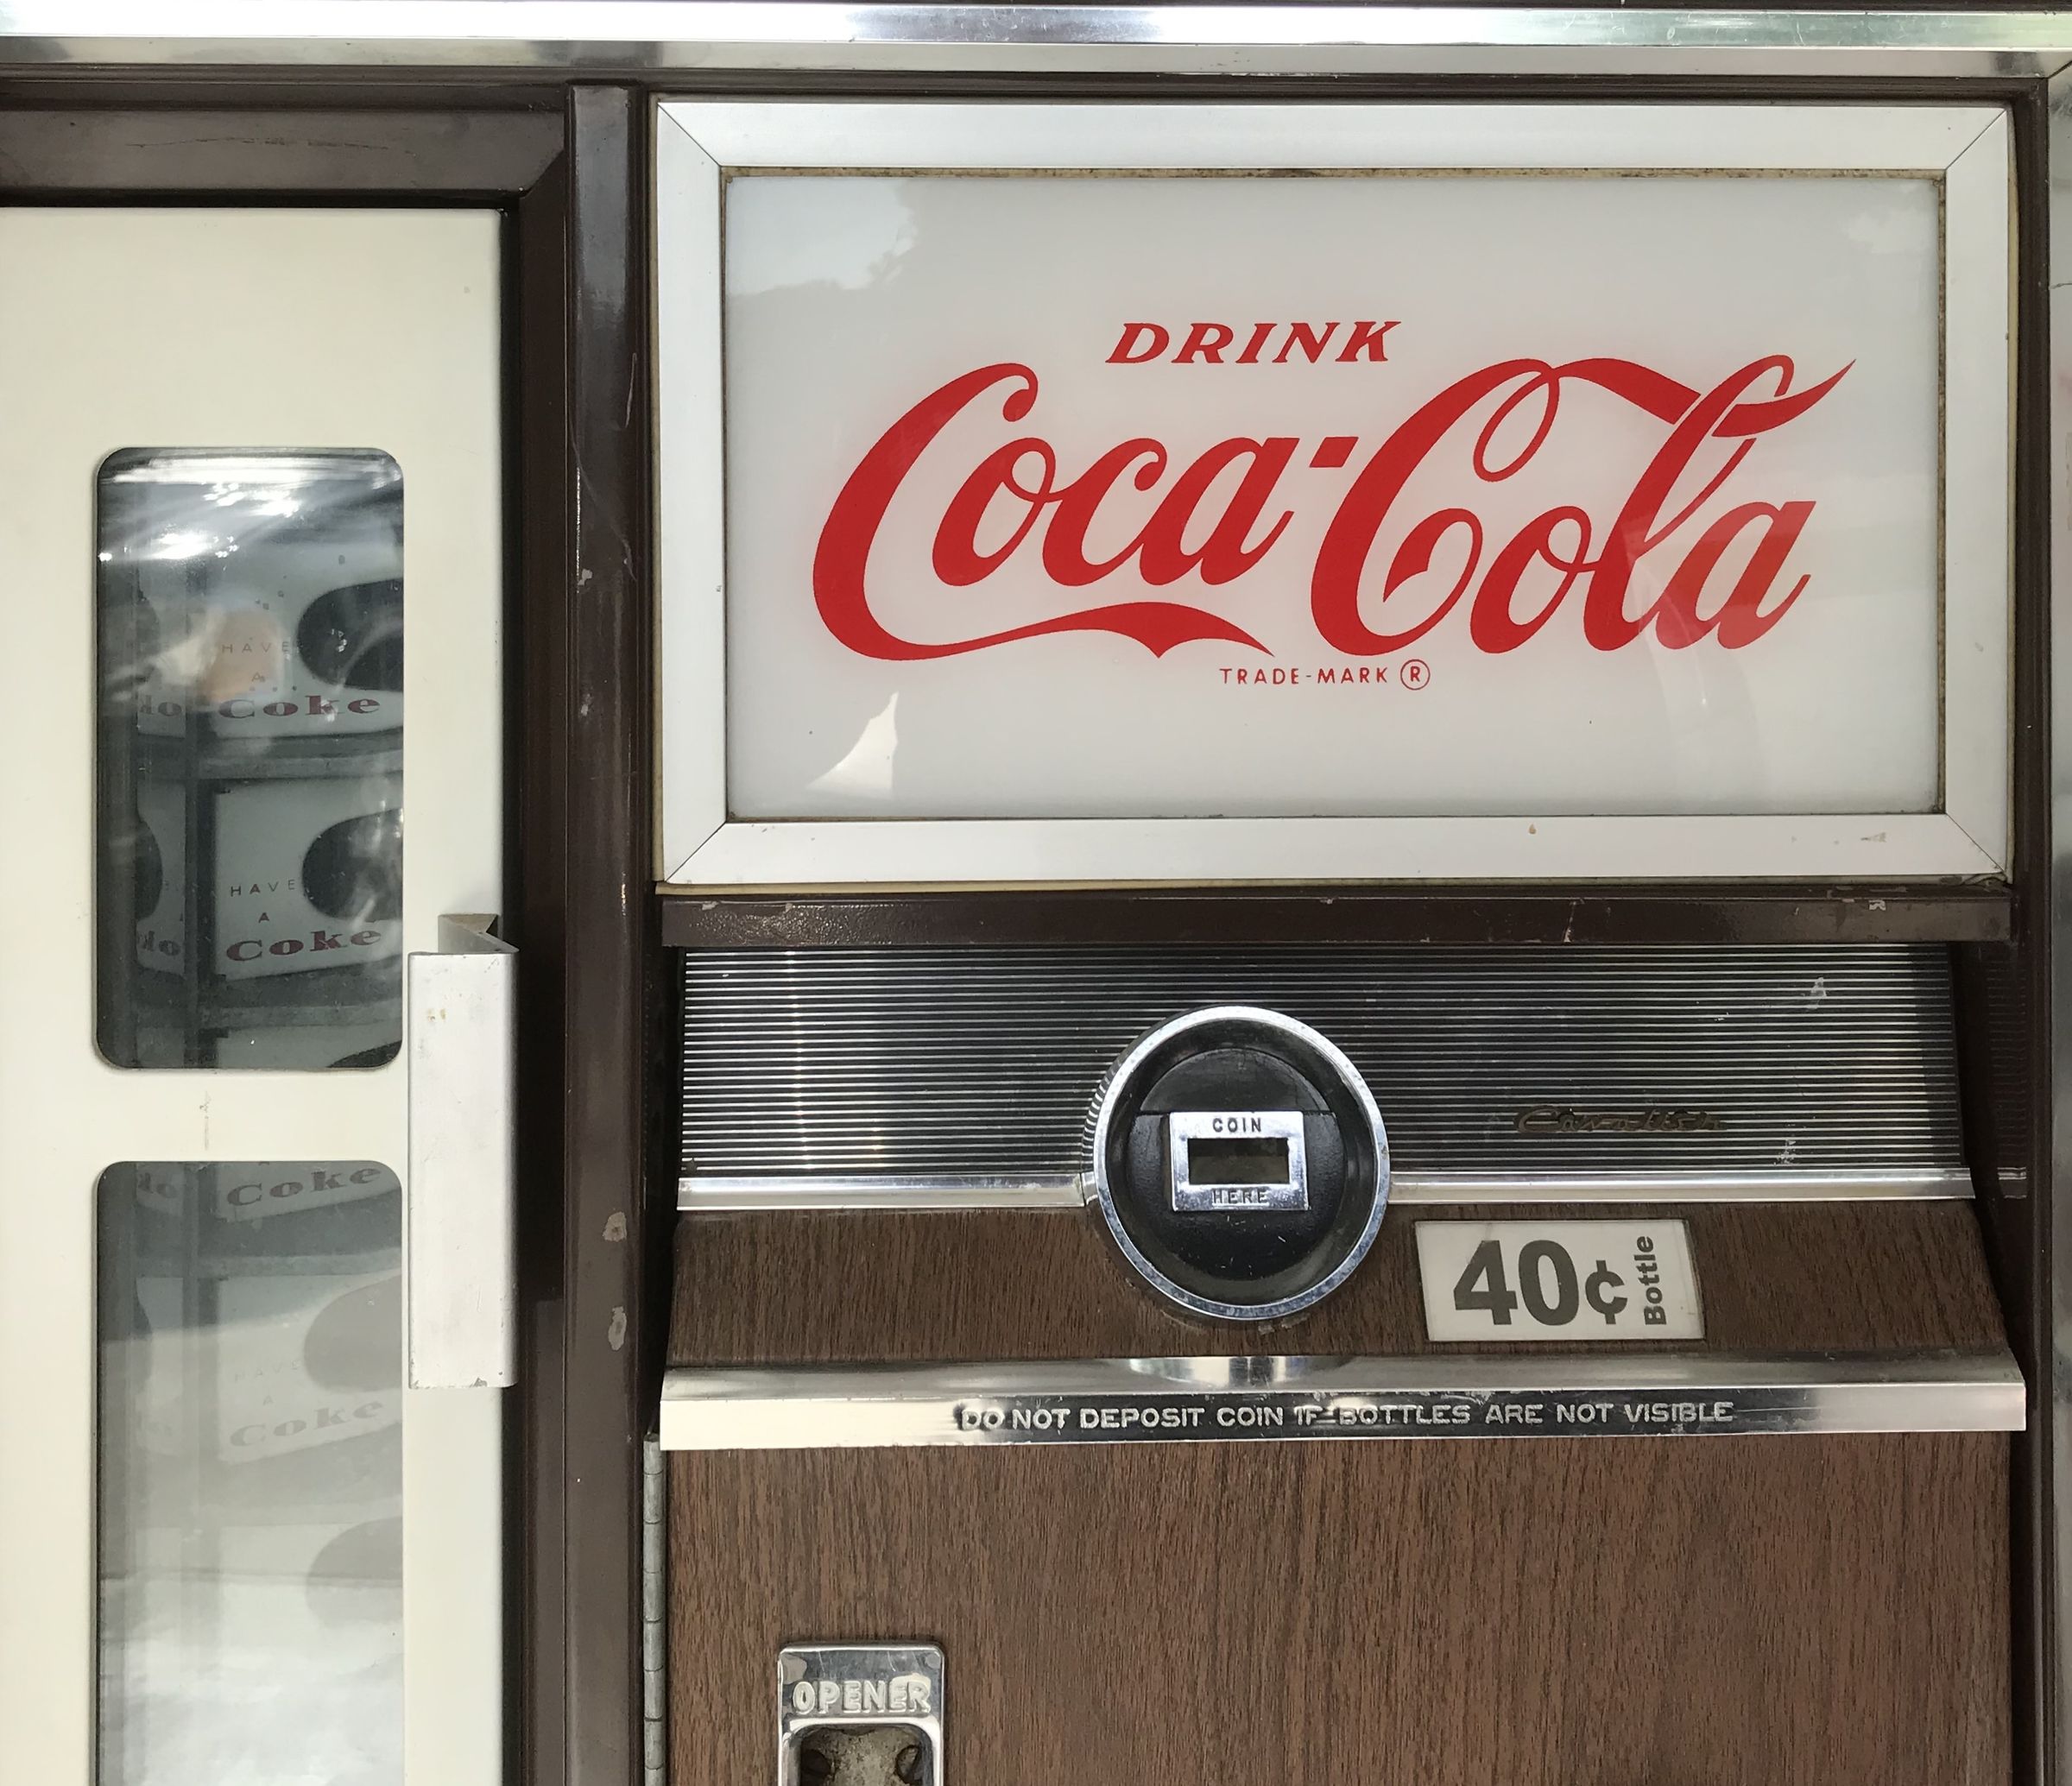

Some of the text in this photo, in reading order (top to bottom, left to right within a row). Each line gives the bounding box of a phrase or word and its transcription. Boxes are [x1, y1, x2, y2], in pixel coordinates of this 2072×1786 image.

[1105, 320, 1401, 363] DRINK
[812, 353, 1855, 660] Coca-Cola
[221, 641, 289, 653] HAVE
[1219, 666, 1388, 685] TRADE-MARK
[218, 695, 381, 719] Coke
[231, 879, 296, 897] HAVE
[258, 912, 270, 923] A
[226, 930, 382, 962] Coke
[1212, 1117, 1262, 1133] COIN
[227, 1168, 382, 1206] Coke
[1212, 1190, 1269, 1205] HERE
[1453, 1239, 1628, 1326] 40¢
[1633, 1235, 1667, 1326] Bottle
[229, 1400, 383, 1447] Coke
[960, 1402, 1734, 1430] DO NOT DEPOSIT COIN IF BOTTLES ARE NOT VISIBLE
[793, 1680, 932, 1715] OPENER
